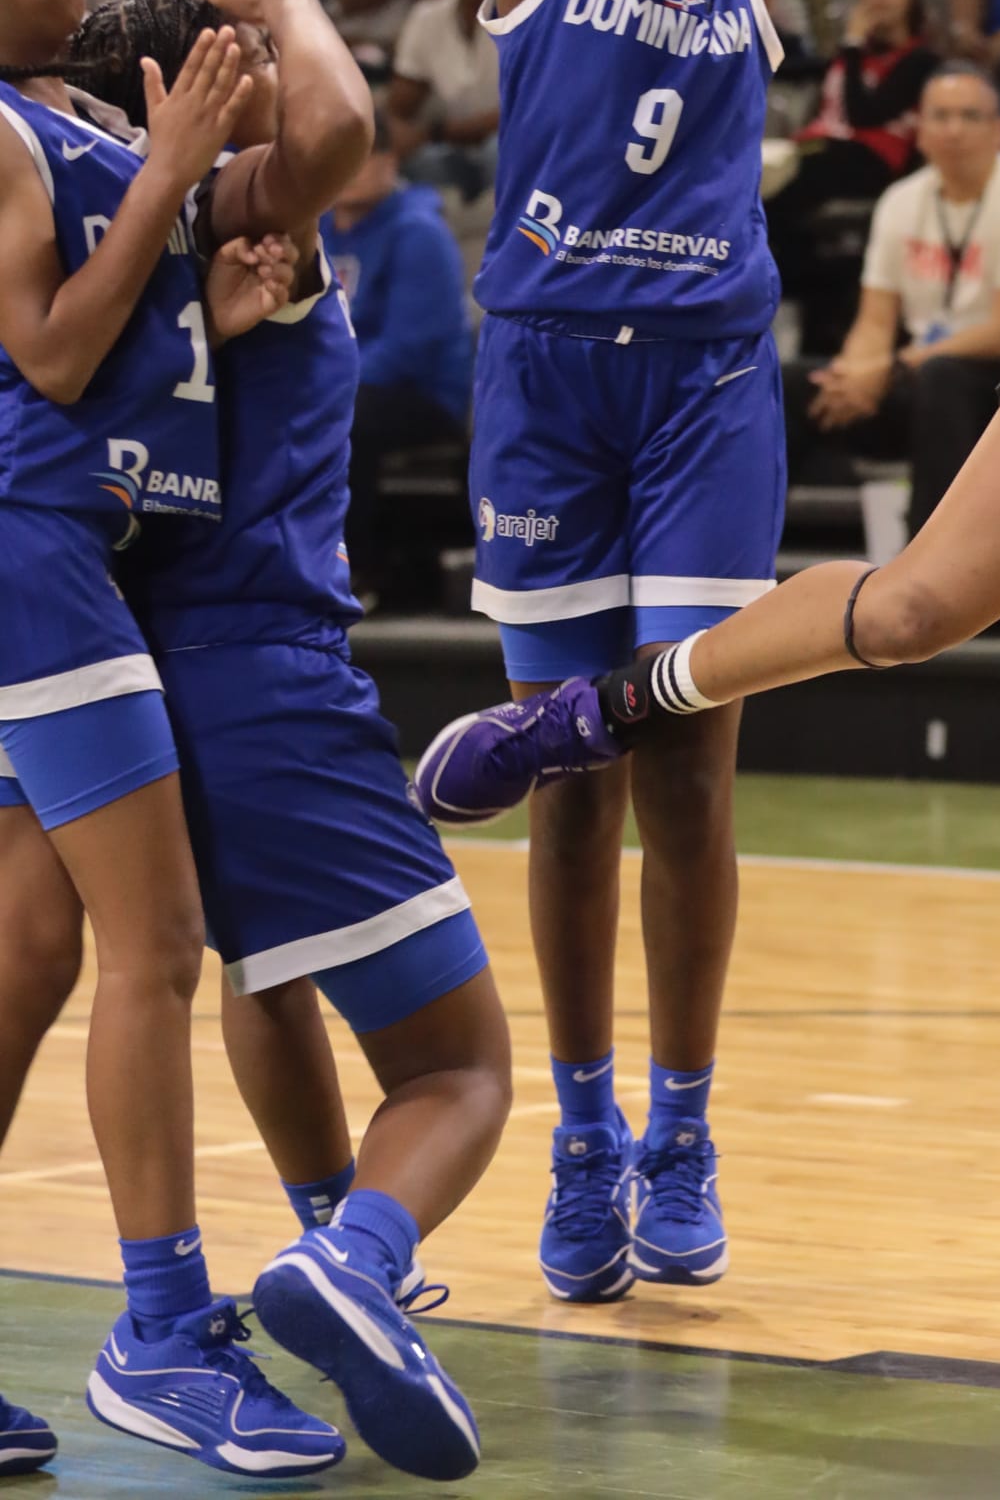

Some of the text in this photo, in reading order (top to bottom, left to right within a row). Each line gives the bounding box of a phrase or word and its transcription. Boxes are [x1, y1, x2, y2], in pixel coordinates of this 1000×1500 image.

[624, 88, 684, 175] 9
[563, 224, 731, 261] BANRESERVAS
[612, 254, 647, 268] todos
[647, 256, 663, 270] los
[496, 509, 560, 547] arajet
